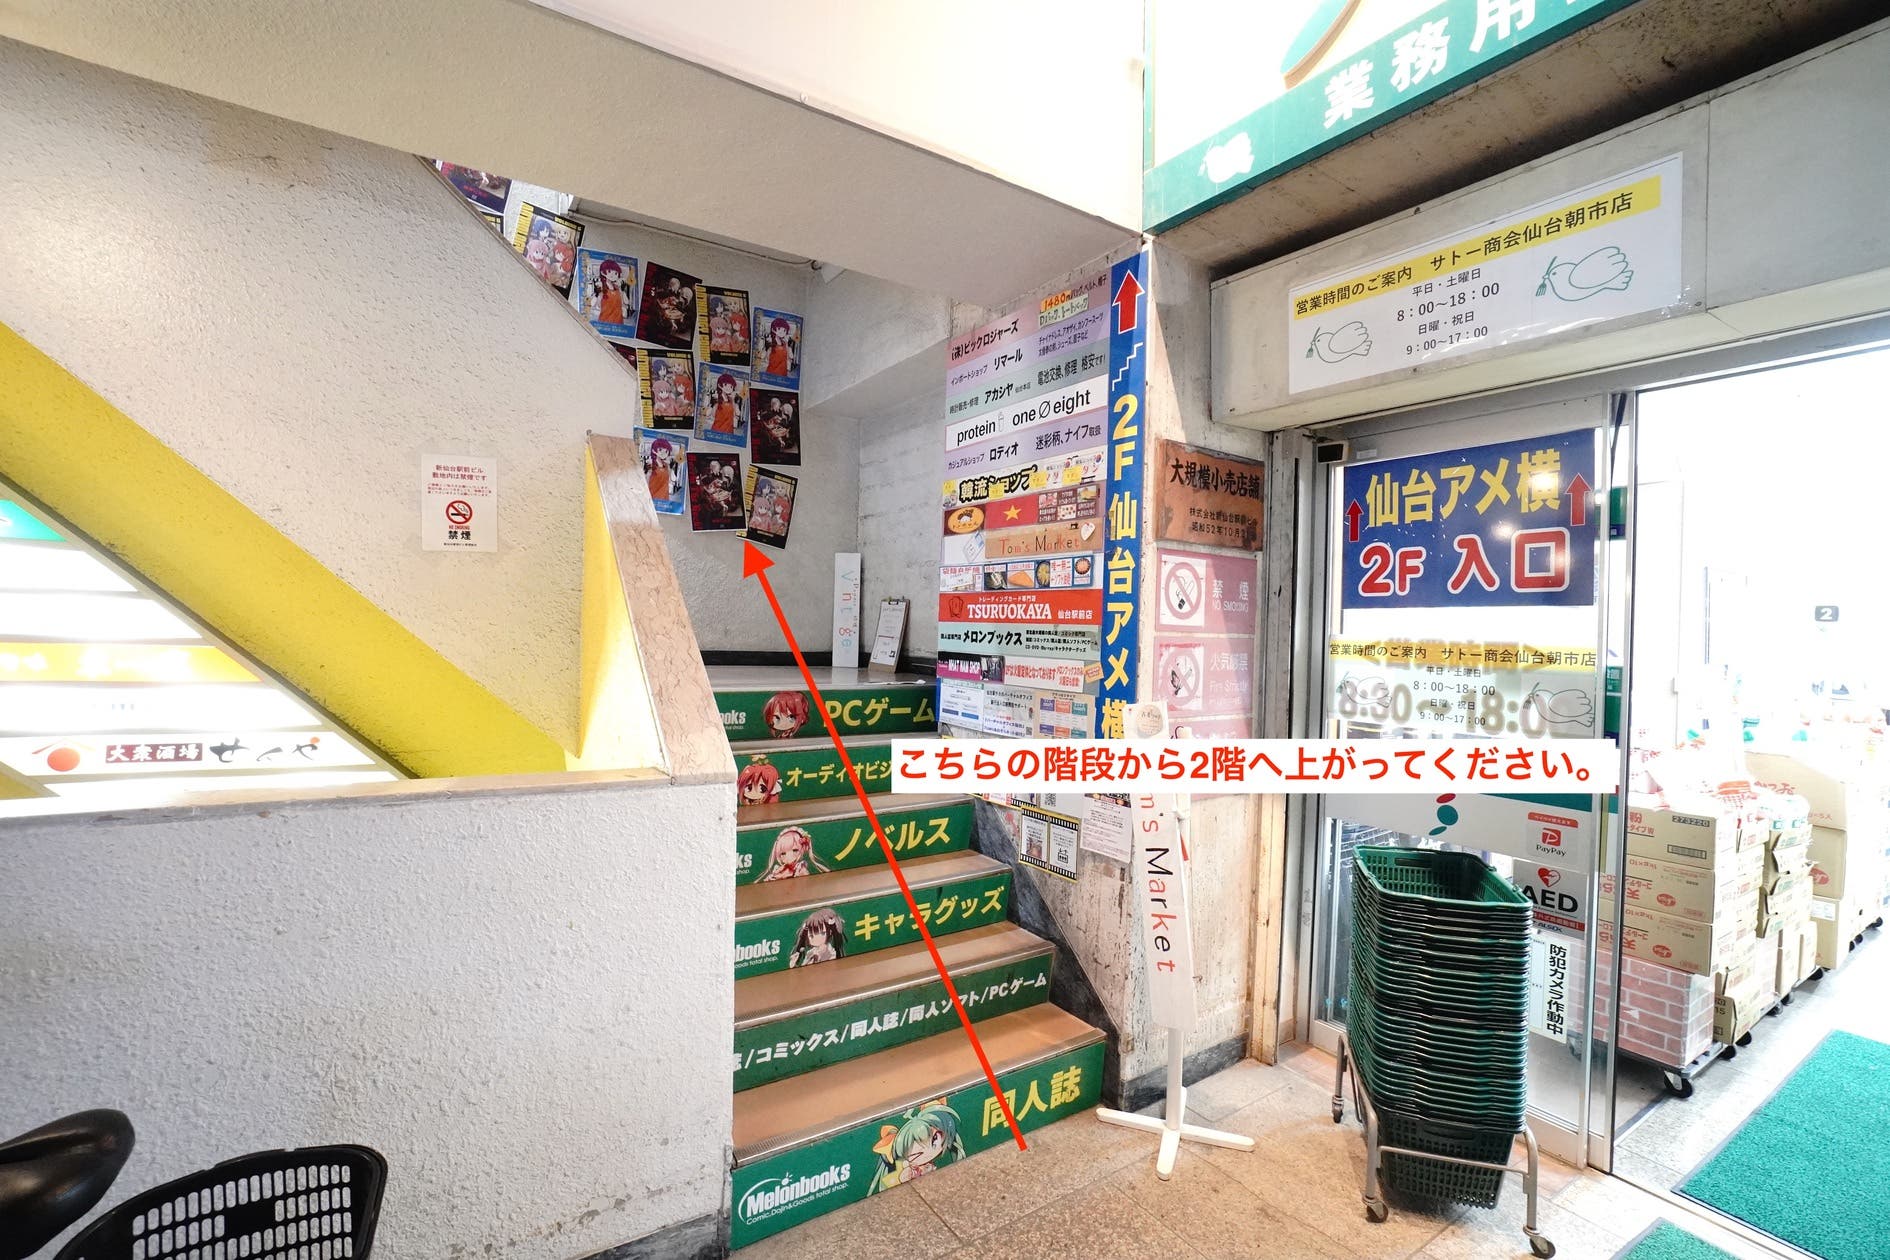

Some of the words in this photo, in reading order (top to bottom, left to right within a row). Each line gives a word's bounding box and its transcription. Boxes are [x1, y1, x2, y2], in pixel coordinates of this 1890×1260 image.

[1296, 265, 1412, 316] 営業時間のご案内
[1430, 192, 1634, 272] サトー商会仙台朝市店
[1411, 267, 1482, 298] 平日・土曜日
[1417, 311, 1476, 336] 日曜・祝日
[994, 348, 1023, 371] リマール
[984, 383, 1014, 405] アカシヤ
[957, 418, 996, 446] protein
[1112, 393, 1139, 481] 2F
[948, 453, 985, 470] カジュアルショップ
[989, 442, 1019, 462] ロティオ
[1170, 457, 1261, 500] 大規模小売店舗
[1366, 448, 1562, 529] 仙台アメ横
[448, 530, 471, 541] 禁煙
[1035, 535, 1081, 553] Market
[1358, 541, 1426, 597] 2F
[1447, 526, 1571, 595] 入口
[967, 603, 1052, 620] TSURUOKAYA
[1057, 609, 1093, 620] 仙台駅前店
[1820, 609, 1833, 620] 2
[963, 630, 1023, 646] メロンブックス
[1329, 644, 1427, 660] 営業時間のご案内
[1441, 647, 1597, 668] サトー商会仙台朝市店
[823, 697, 935, 728] PCゲーム
[107, 743, 201, 762] 大衆酒場
[786, 760, 892, 787] オーディオビジ
[834, 817, 951, 861] ノベルス
[1536, 843, 1567, 857] PayPay
[1145, 847, 1177, 972] Market
[1522, 885, 1579, 913] AED
[854, 886, 1005, 941] キャラグッズ
[735, 938, 781, 961] books
[1546, 943, 1568, 1035] 防犯カメラ作動中
[981, 1065, 1082, 1137] 同人誌
[746, 1162, 851, 1219] Melonbooks
